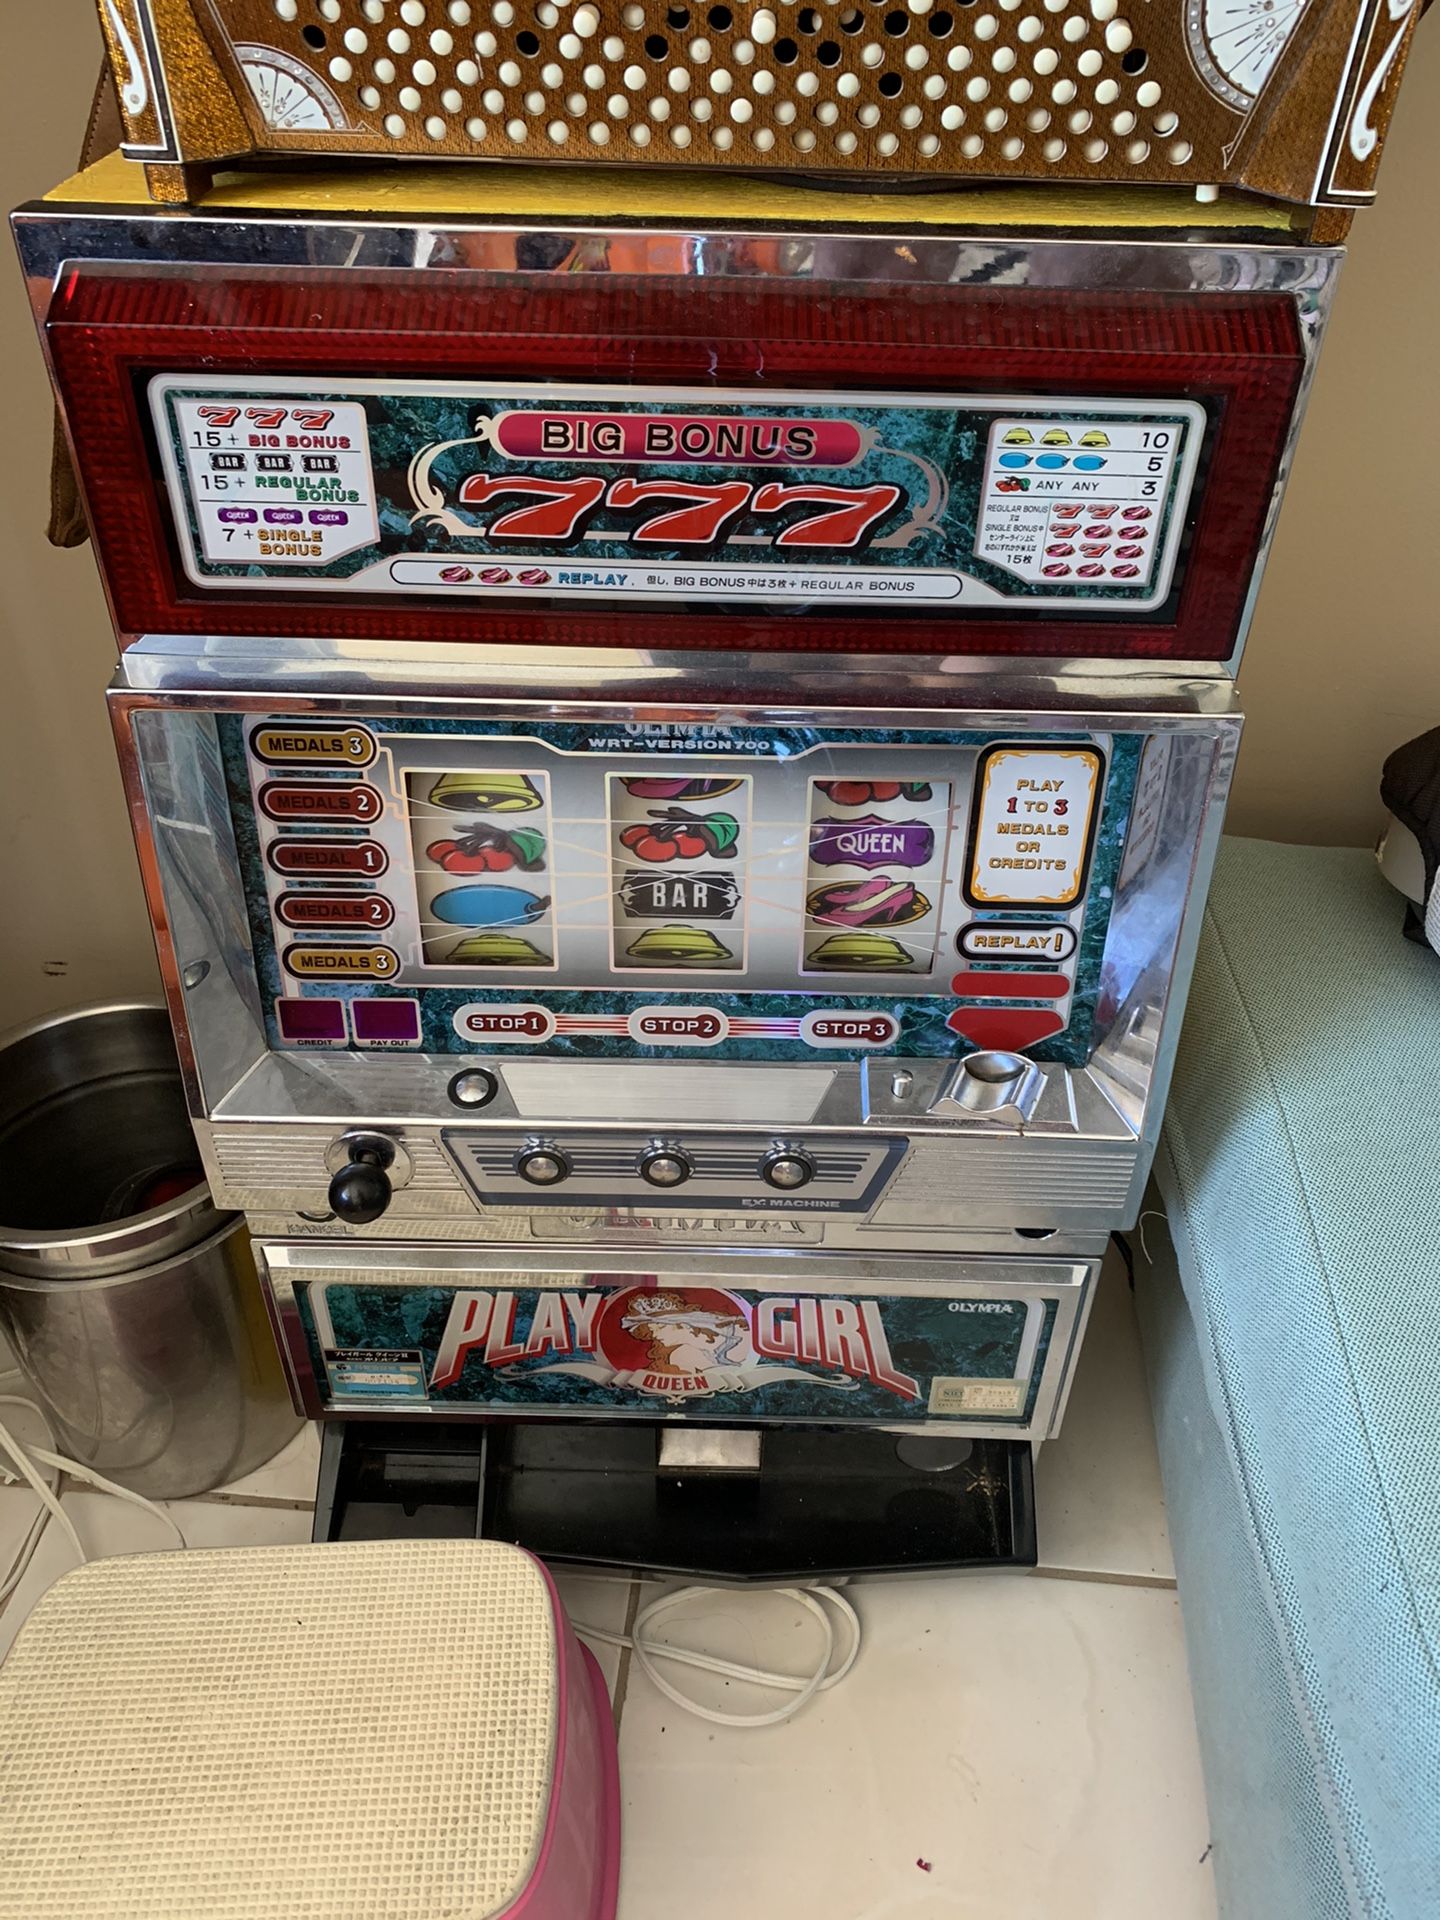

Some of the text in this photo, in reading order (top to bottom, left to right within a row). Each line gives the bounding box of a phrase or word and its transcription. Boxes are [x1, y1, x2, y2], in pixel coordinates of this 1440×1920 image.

[193, 431, 221, 447] 15
[248, 434, 281, 447] BIG
[286, 435, 351, 449] BONUS
[541, 418, 818, 460] BIG BONUS
[1141, 431, 1170, 449] 10
[218, 456, 331, 469] BAR BAR BAR
[1147, 457, 1164, 472] 5
[201, 475, 229, 490] 15
[255, 475, 342, 489] REGULAR
[1035, 481, 1157, 496] ANY ANY 3
[296, 489, 360, 502] BONUS
[226, 511, 340, 521] QUEEN QUEEN QUEEN
[1023, 505, 1049, 514] BONUS
[222, 528, 235, 542] 7
[257, 528, 323, 542] SINGLE
[260, 543, 322, 556] BONUS
[674, 576, 695, 586] BIG
[699, 577, 745, 588] BONUS
[800, 580, 863, 590] REGULAR
[869, 581, 915, 592] BONUS
[268, 737, 364, 754] MEDALS 3
[588, 738, 770, 750] WRT-VERSION 700
[1016, 779, 1064, 791] PLAY
[277, 794, 369, 811] MEDALS 2
[1006, 797, 1069, 815] 1 TO 3
[996, 823, 1069, 836] MEDALS
[836, 833, 905, 854] QUEEN
[1016, 841, 1040, 853] OR
[291, 851, 375, 867] MEDAL 1
[988, 857, 1067, 870] CREDITS
[652, 882, 708, 909] BAR
[294, 904, 382, 920] MEDALS 2
[300, 954, 389, 970] MEDALS 3
[471, 1017, 539, 1031] STOP 1
[643, 1019, 713, 1033] STOP 2
[816, 1022, 886, 1036] STOP 3
[296, 1039, 333, 1047] CREDIT
[370, 1039, 388, 1047] PAY
[770, 1199, 840, 1209] MACHINE
[948, 1301, 1015, 1314] OLYMPIA
[428, 1290, 923, 1401] PLAY GIRL
[642, 1371, 710, 1391] QUEEN
